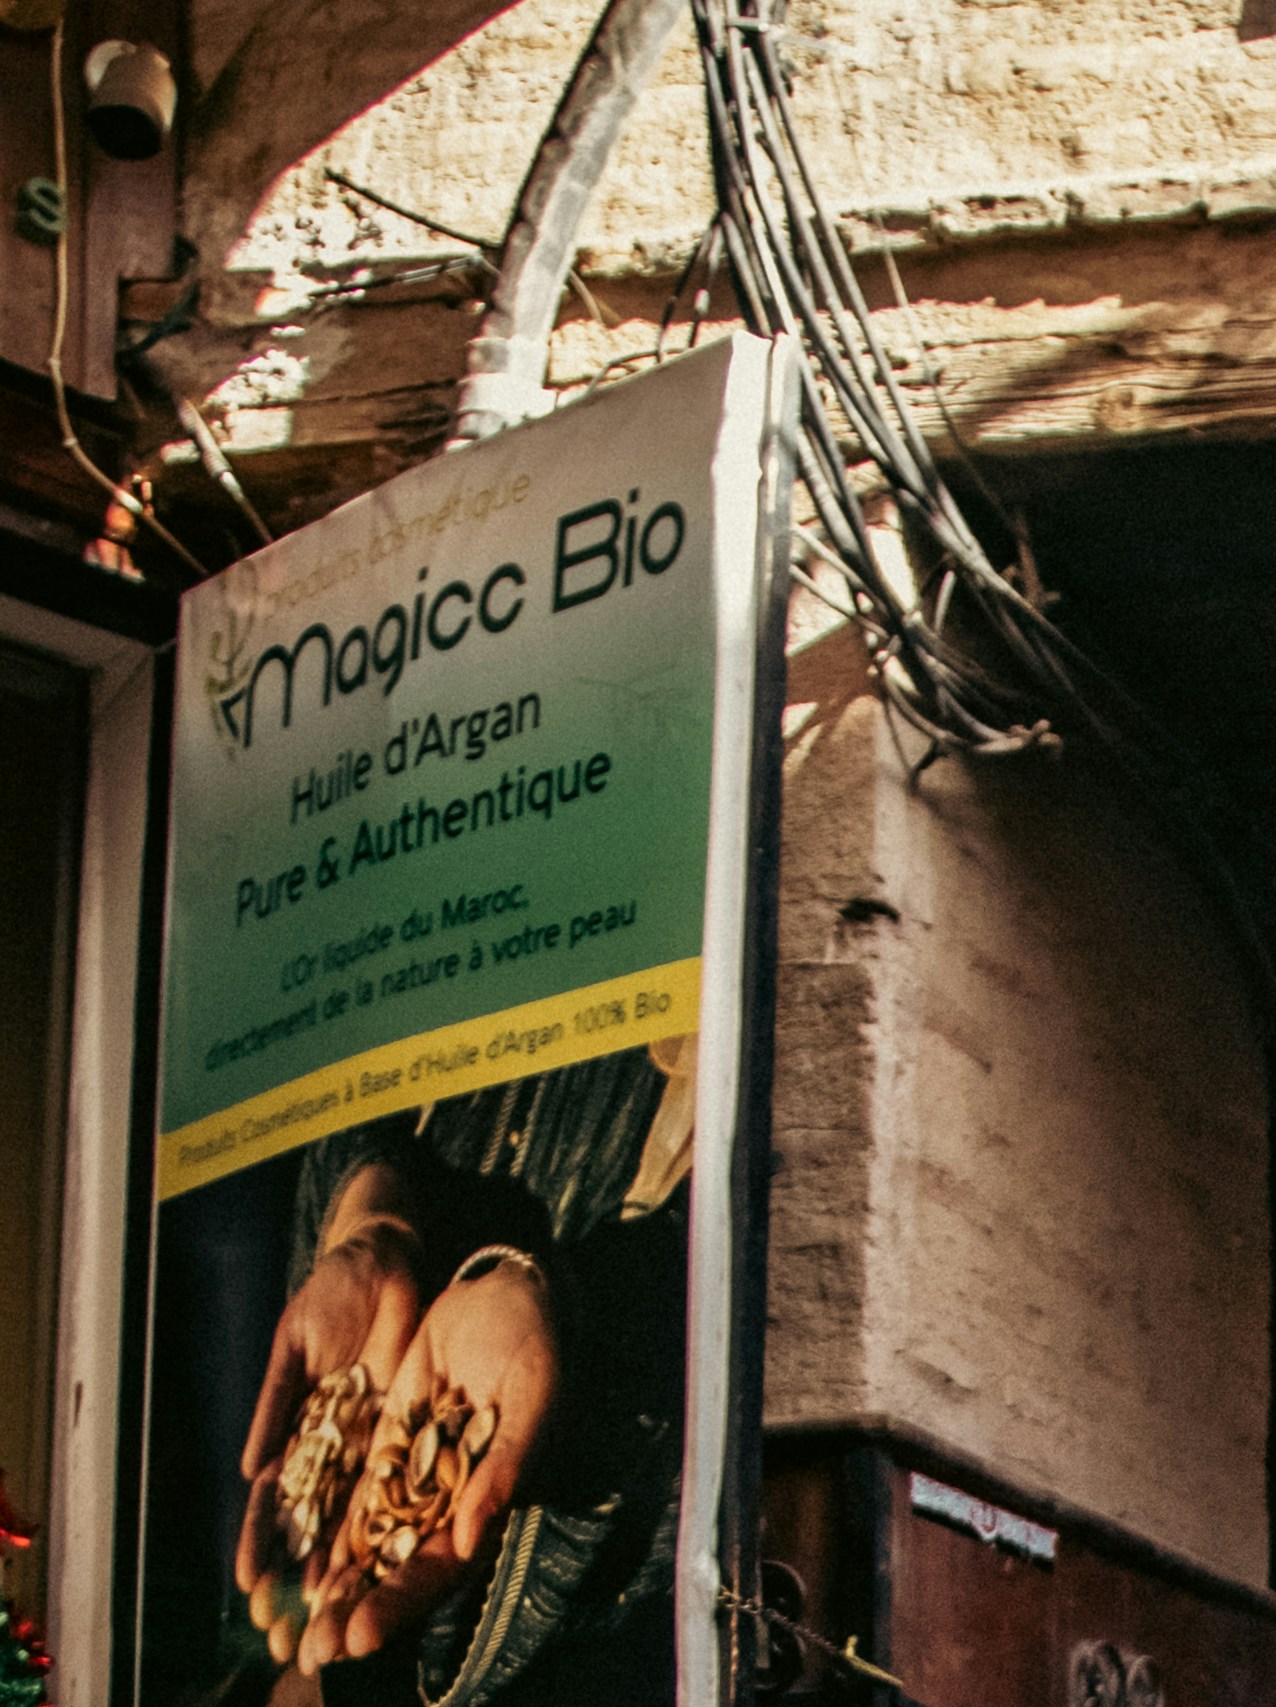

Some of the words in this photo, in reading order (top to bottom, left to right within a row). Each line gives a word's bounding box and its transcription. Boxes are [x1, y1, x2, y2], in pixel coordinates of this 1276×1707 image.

[221, 562, 526, 748] Magicc
[552, 487, 685, 614] Bio
[289, 749, 373, 825] Huile
[384, 692, 541, 776] d'Argan
[234, 864, 306, 929] Pure
[316, 836, 341, 889] &
[348, 752, 612, 876] Authentique
[205, 999, 317, 1072] directement
[322, 988, 350, 1020] de
[355, 977, 374, 1007] la
[380, 952, 461, 998] nature
[468, 939, 484, 971] à
[491, 922, 562, 965] votre
[568, 899, 638, 951] peau
[322, 924, 394, 973] liquide
[400, 908, 433, 942] du
[344, 1080, 354, 1103] à
[360, 1067, 403, 1098] Base
[409, 1042, 480, 1081] d'Huile
[485, 1022, 564, 1060] d'Argan
[573, 999, 628, 1035] 100%
[634, 991, 672, 1020] Bio
